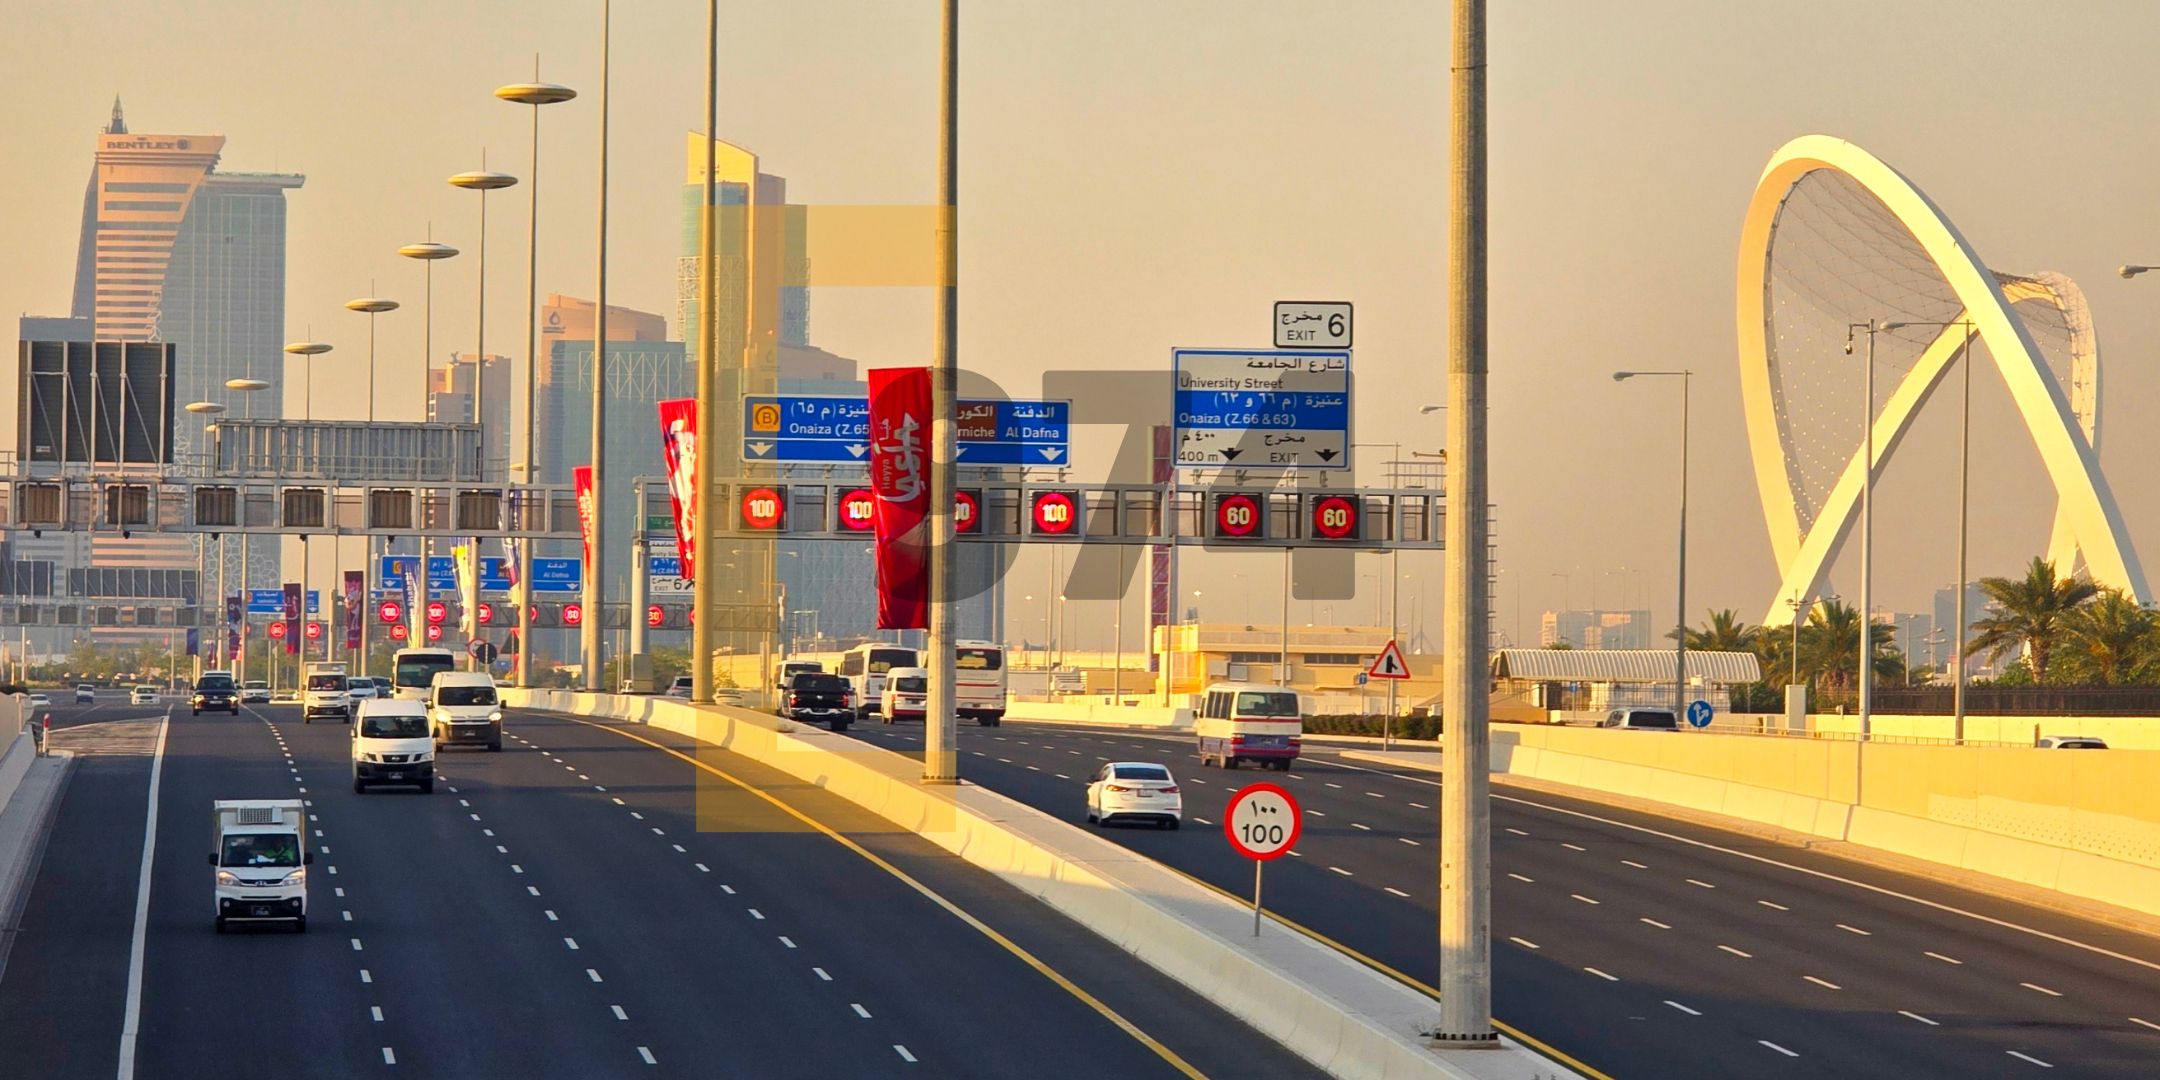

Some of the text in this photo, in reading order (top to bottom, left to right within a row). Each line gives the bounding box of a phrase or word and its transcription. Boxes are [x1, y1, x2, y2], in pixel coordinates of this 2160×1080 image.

[106, 140, 175, 149] BENTLEY
[1281, 311, 1323, 325] مخرج
[1327, 313, 1345, 338] 6
[1287, 330, 1316, 341] EXIT
[1247, 357, 1345, 373] شارع الجامعة
[1180, 377, 1284, 390] University Street
[838, 403, 869, 418] نيزة
[957, 405, 994, 420] الكور
[1179, 413, 1221, 425] Onaiza
[789, 423, 870, 437] Onaiza (Z.65
[957, 426, 996, 438] rniche
[1005, 427, 1060, 439] Al Dafna
[1264, 432, 1306, 447] مخرج
[1179, 452, 1219, 462] 400 m
[1270, 453, 1299, 463] EXIT
[882, 458, 893, 490] Hayya
[749, 499, 776, 518] 100
[848, 501, 873, 519] 100
[1042, 504, 1068, 522] 100
[1226, 506, 1250, 525] 60
[1323, 508, 1347, 527] 60
[674, 578, 682, 590] 6
[1251, 800, 1277, 817] ١٠٠
[1242, 824, 1283, 845] 100
